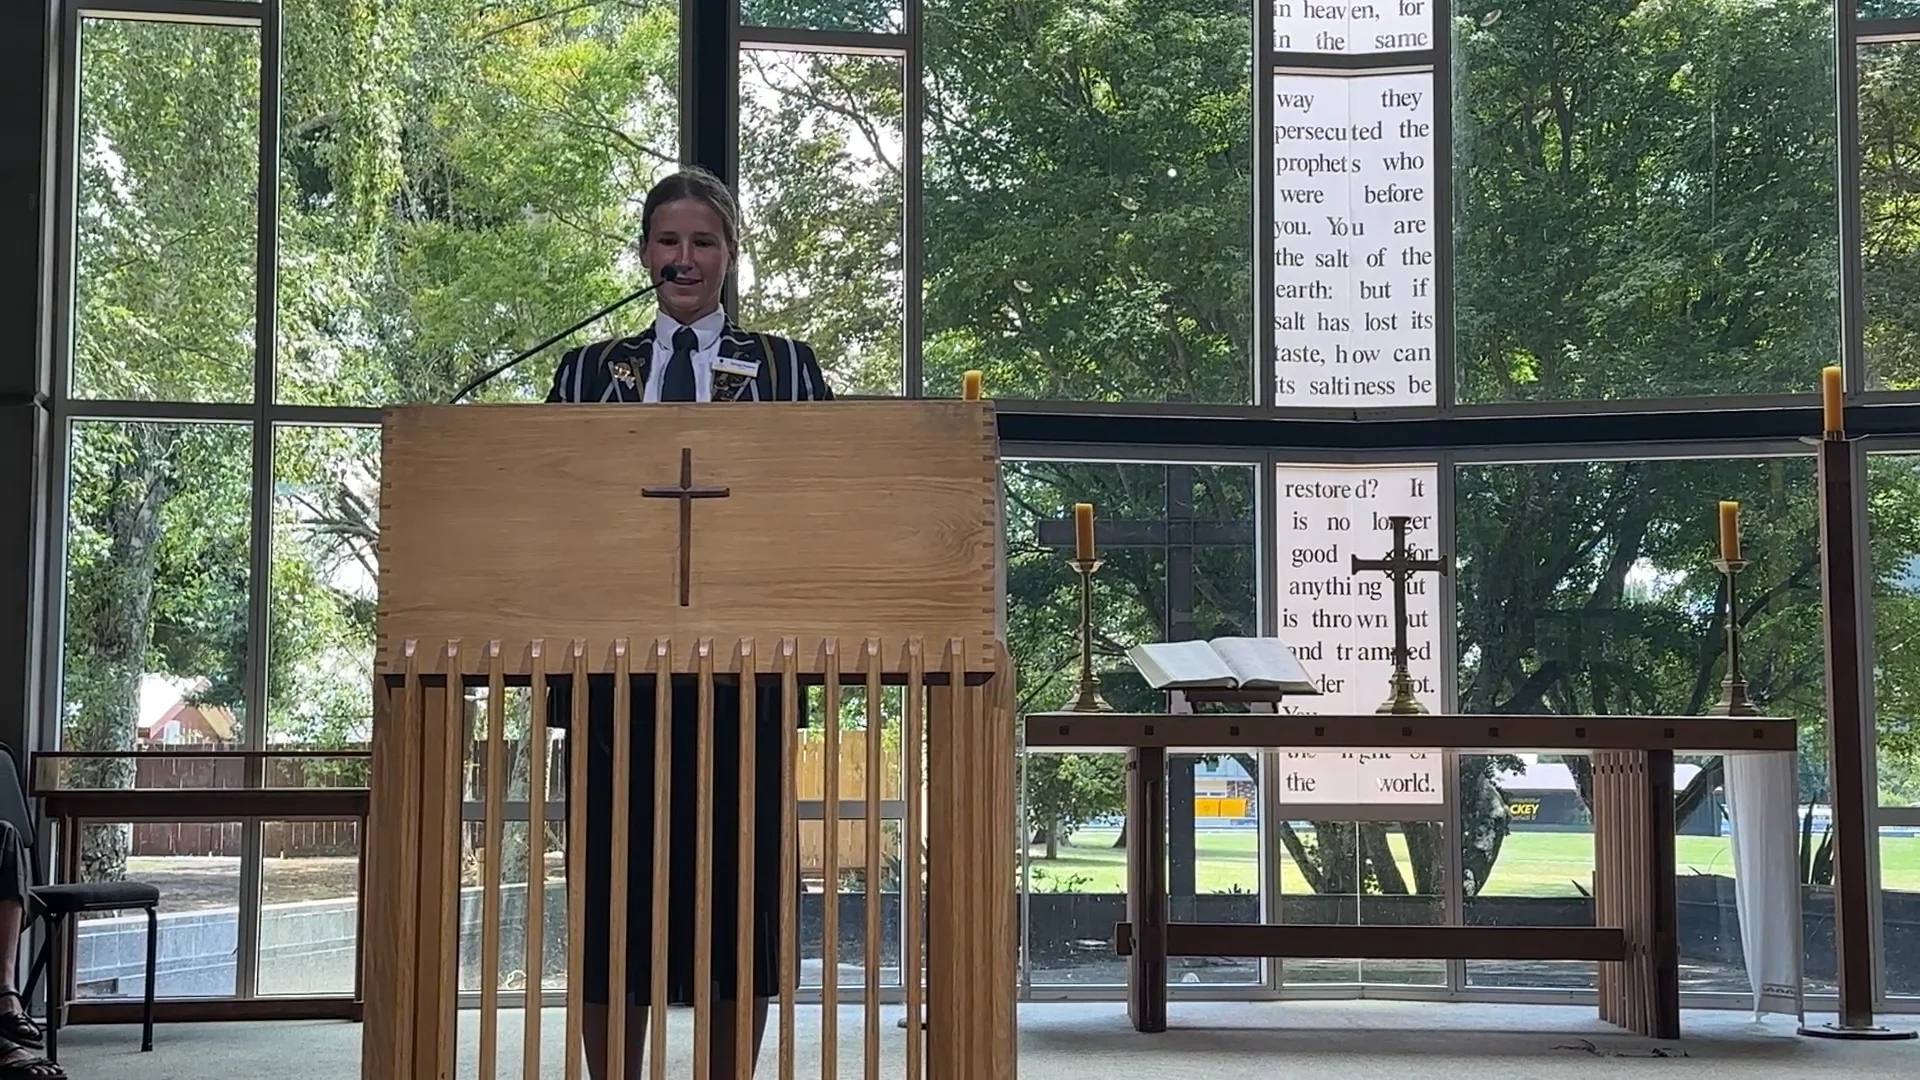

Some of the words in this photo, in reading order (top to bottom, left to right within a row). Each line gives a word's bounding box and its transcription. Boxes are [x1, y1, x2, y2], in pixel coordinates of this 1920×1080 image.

[1273, 0, 1291, 18] in
[1303, 0, 1380, 21] heaven,
[1399, 0, 1425, 16] for
[1273, 29, 1291, 49] in
[1316, 31, 1345, 51] the
[1375, 32, 1428, 49] same
[1277, 94, 1314, 114] way
[1381, 88, 1423, 112] they
[1275, 120, 1383, 145] persecuted
[1399, 119, 1430, 139] the
[1276, 153, 1361, 177] prophets
[1382, 151, 1425, 171] who
[1280, 189, 1324, 204] were
[1364, 182, 1424, 204] before
[1275, 221, 1312, 239] you.
[1326, 216, 1365, 237] You
[1393, 219, 1427, 235] are
[1275, 247, 1305, 267] the
[1315, 248, 1349, 268] salt
[1366, 247, 1388, 268] of
[1401, 246, 1432, 266] the
[1275, 279, 1333, 300] earth:
[1359, 280, 1392, 300] but
[1412, 277, 1430, 298] if
[1275, 311, 1305, 331] salt
[1317, 311, 1350, 332] has
[1364, 311, 1398, 332] lost
[1411, 310, 1433, 330] its
[1275, 345, 1326, 367] taste,
[1335, 344, 1381, 364] how
[1393, 347, 1431, 363] can
[1276, 375, 1296, 395] its
[1309, 375, 1396, 396] saltiness
[1408, 374, 1432, 394] be
[1285, 478, 1379, 499] restored?
[1410, 477, 1424, 498] It
[1293, 510, 1308, 531] is
[1327, 516, 1351, 531] no
[1291, 543, 1338, 568] good
[1288, 575, 1383, 601] anything
[1405, 575, 1426, 596] ut
[1283, 607, 1299, 628] is
[1311, 608, 1388, 629] thrown
[1406, 609, 1429, 628] ut
[1336, 640, 1431, 666] tramed
[1316, 673, 1345, 693] der
[1412, 675, 1435, 693] ot.
[1286, 771, 1316, 792] the
[1378, 772, 1436, 793] world.
[1510, 804, 1540, 815] CKEY
